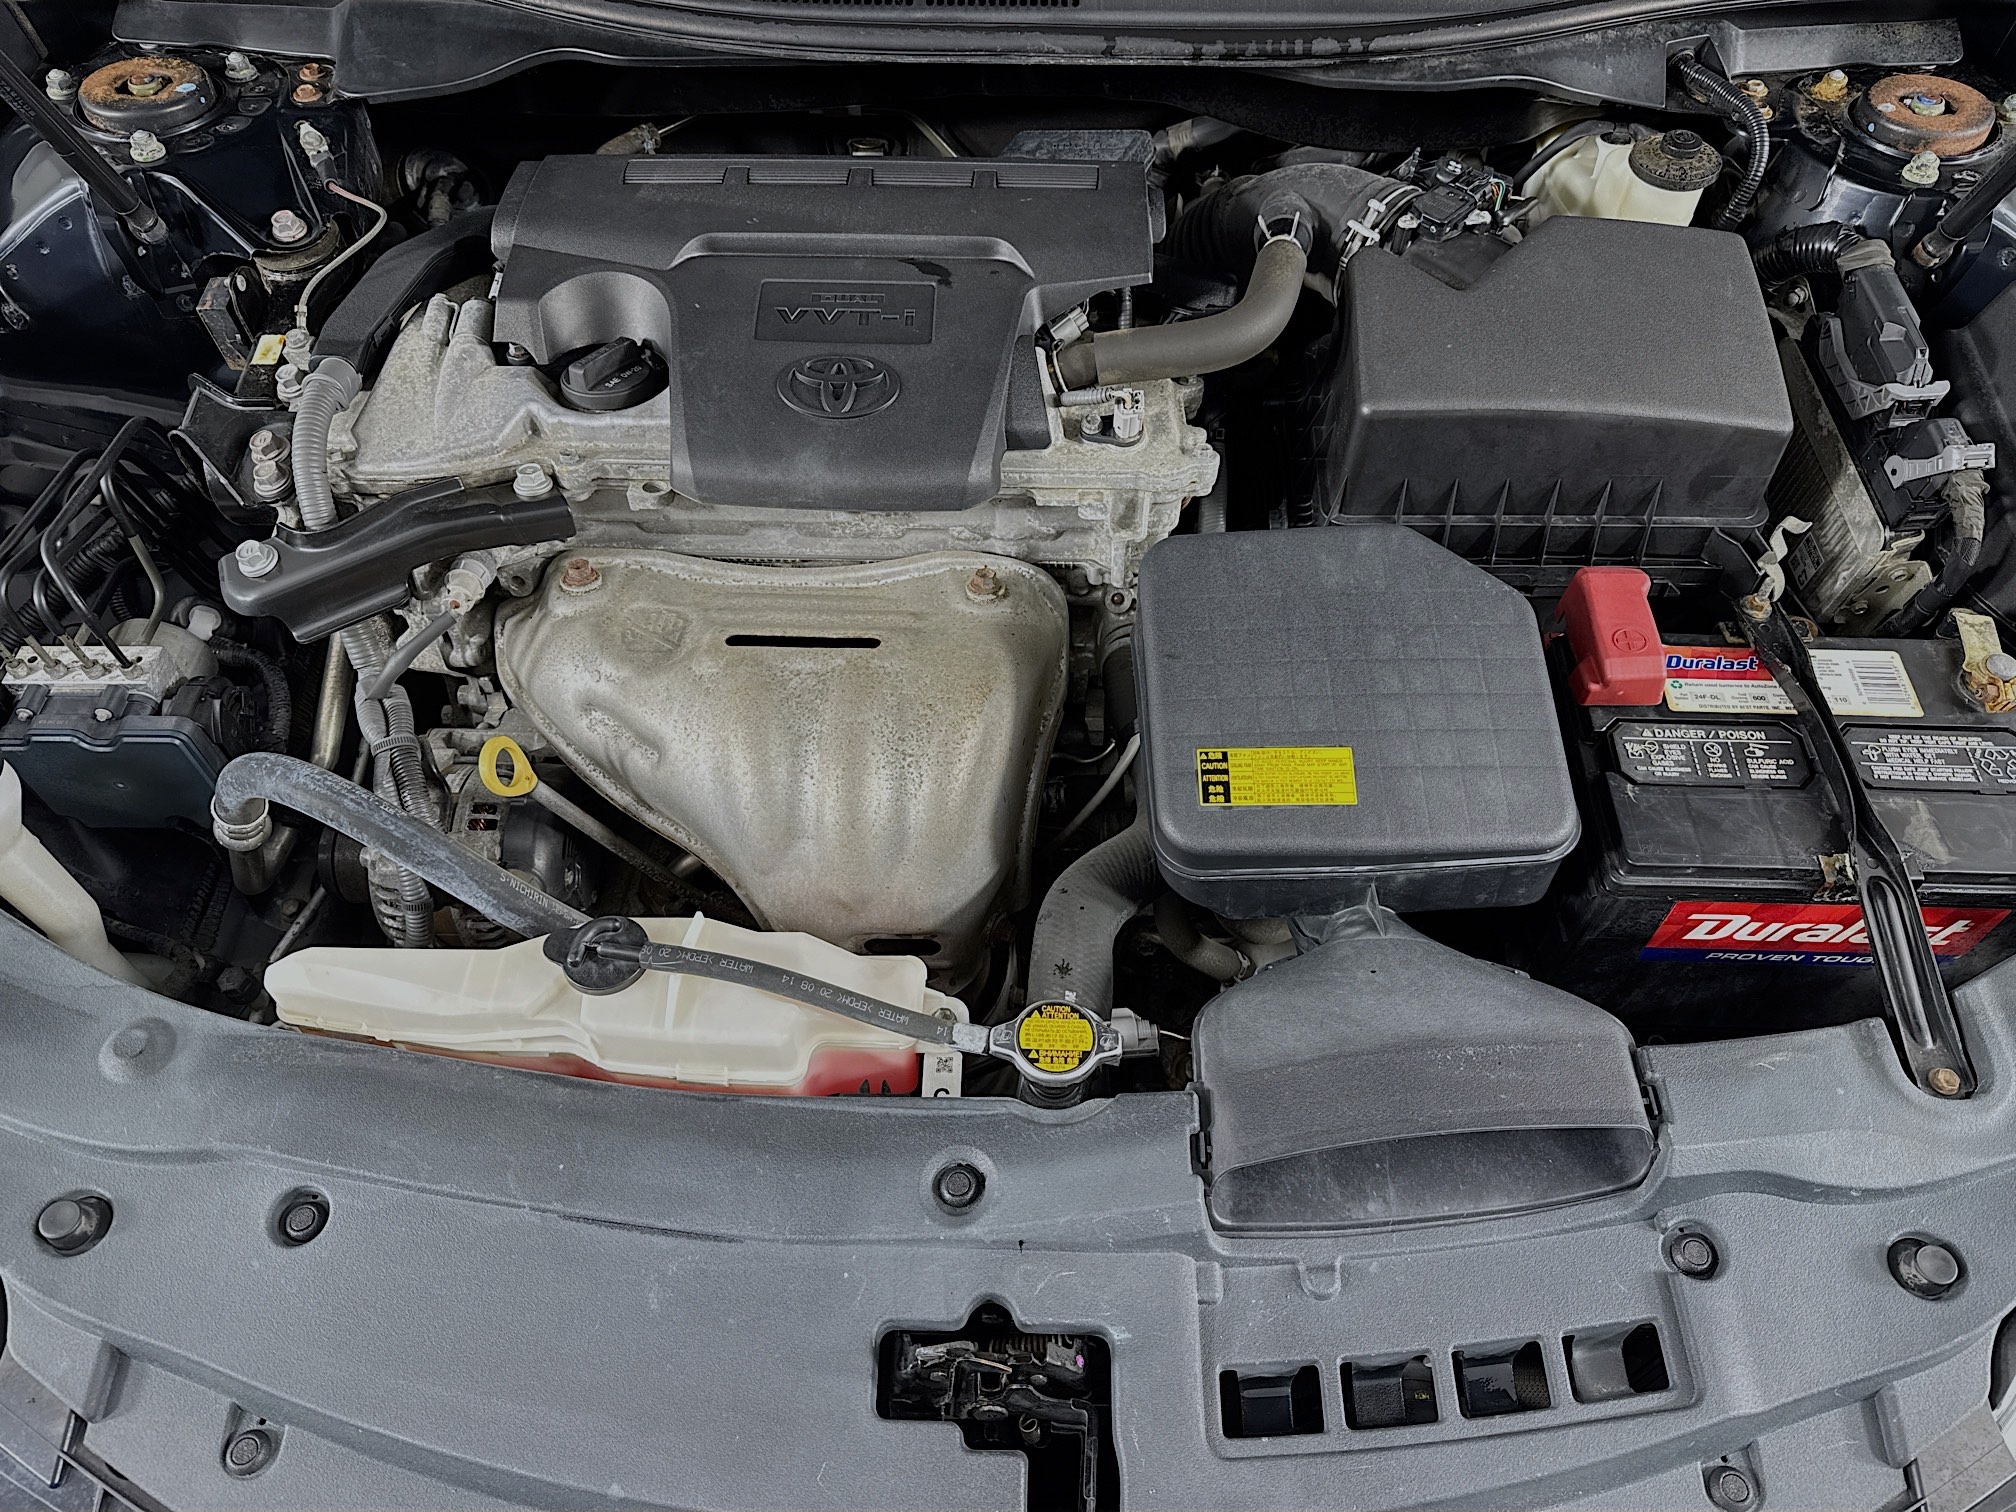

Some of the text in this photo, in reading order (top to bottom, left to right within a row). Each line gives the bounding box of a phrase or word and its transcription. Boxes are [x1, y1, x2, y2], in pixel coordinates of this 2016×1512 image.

[774, 307, 916, 326] VVT-i
[604, 377, 621, 388] SAE
[1666, 654, 1758, 671] Duralast
[1654, 728, 1706, 739] DANGER
[1719, 730, 1766, 740] POISON
[1201, 762, 1228, 770] CAUTION
[1203, 774, 1229, 782] ATTENTION
[1682, 913, 1972, 946] Duralt
[658, 946, 671, 958] 20
[1705, 952, 1877, 964] PROVEN TOUG
[719, 957, 754, 974] WATER
[782, 974, 794, 985] 14
[800, 981, 814, 992] 08
[820, 987, 833, 998] 20
[1041, 1005, 1071, 1013] CAUTION
[878, 1008, 909, 1026] WATER
[936, 1025, 948, 1037] 14
[1039, 1050, 1082, 1058] ВНИМАНИЕ!
